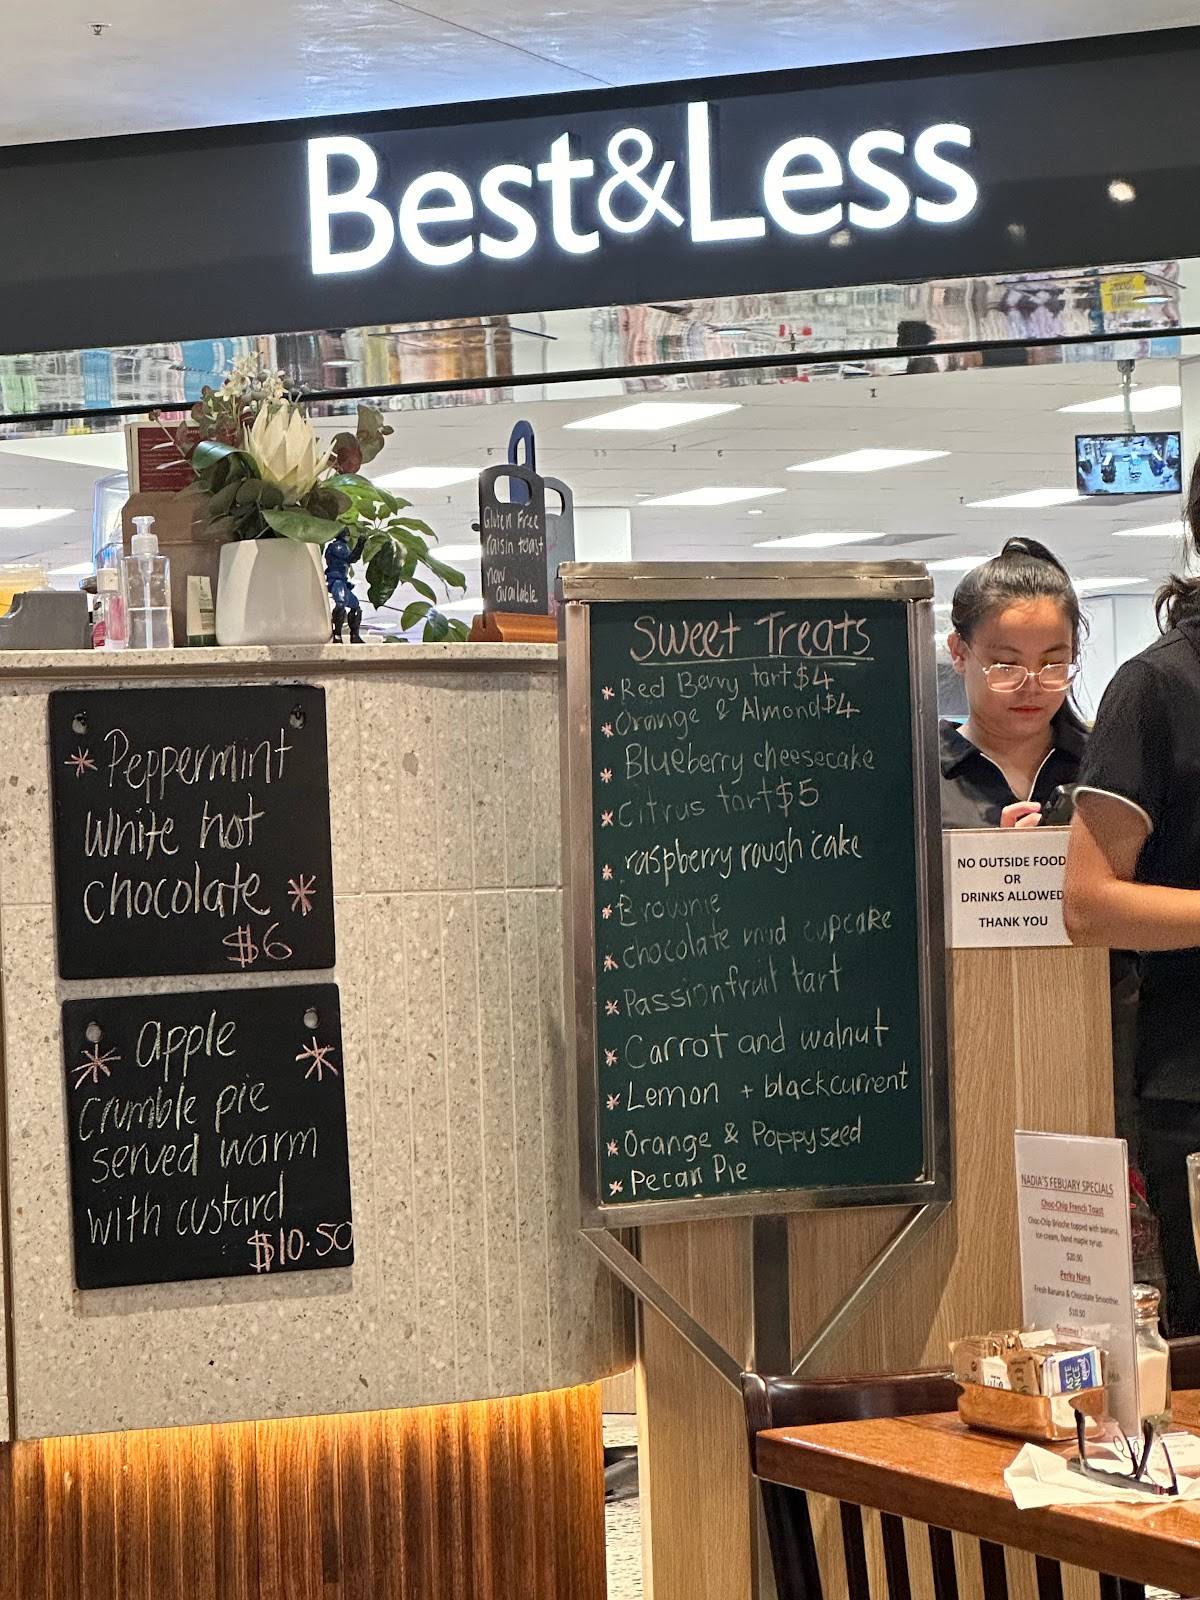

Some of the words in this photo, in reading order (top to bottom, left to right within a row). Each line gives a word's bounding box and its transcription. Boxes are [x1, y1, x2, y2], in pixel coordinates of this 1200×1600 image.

[307, 101, 979, 276] Best&Less
[483, 506, 512, 530] Gluten
[517, 510, 539, 530] Free
[486, 534, 514, 555] raisin
[518, 536, 544, 556] toast
[487, 567, 506, 586] now
[495, 581, 538, 603] available
[630, 612, 741, 661] Sweet
[754, 610, 871, 657] Treats
[620, 676, 665, 699] Red
[677, 671, 739, 699] Berry
[752, 663, 791, 688] tart
[615, 709, 700, 739] Orange
[716, 699, 728, 720] &
[103, 728, 293, 804] Peppermint
[625, 742, 743, 784] Blueberry
[754, 740, 875, 772] cheesecake
[200, 793, 265, 850] hot
[618, 792, 705, 827] Citrus
[624, 838, 732, 887] raspberry
[740, 827, 804, 874] rough
[811, 823, 863, 860] cake
[957, 857, 976, 868] NO
[979, 857, 1030, 867] OUTSIDE
[1033, 856, 1066, 866] FOOD
[83, 861, 270, 924] chocolate
[961, 891, 1004, 902] DRINKS
[1008, 890, 1064, 901] ALLOWED
[1003, 874, 1021, 884] OR
[615, 893, 721, 926] Brownie
[979, 917, 1020, 927] THANK
[1022, 916, 1048, 926] YOU
[222, 923, 292, 968] $6
[622, 920, 730, 969] chocolate
[804, 906, 892, 944] cupcake
[623, 955, 778, 1017] Passionfruit
[793, 952, 842, 993] tart
[624, 1024, 729, 1069] Carrot
[738, 1016, 785, 1055] and
[801, 1008, 889, 1050] walnut
[215, 1076, 270, 1133] pie
[627, 1081, 719, 1111] Lemon
[91, 1133, 199, 1183] served
[220, 1127, 317, 1168] warm
[624, 1130, 711, 1162] Orange
[725, 1122, 738, 1144] &
[631, 1165, 702, 1195] Pecan
[714, 1154, 748, 1183] Pie
[1021, 1174, 1049, 1187] NADIA'S
[1081, 1181, 1114, 1195] SPECIALS
[87, 1192, 160, 1246] with
[176, 1170, 285, 1236] custard
[1070, 1220, 1088, 1233] topped
[1088, 1224, 1100, 1232] with
[1088, 1204, 1104, 1214] Toast
[247, 1221, 353, 1273] $10.50
